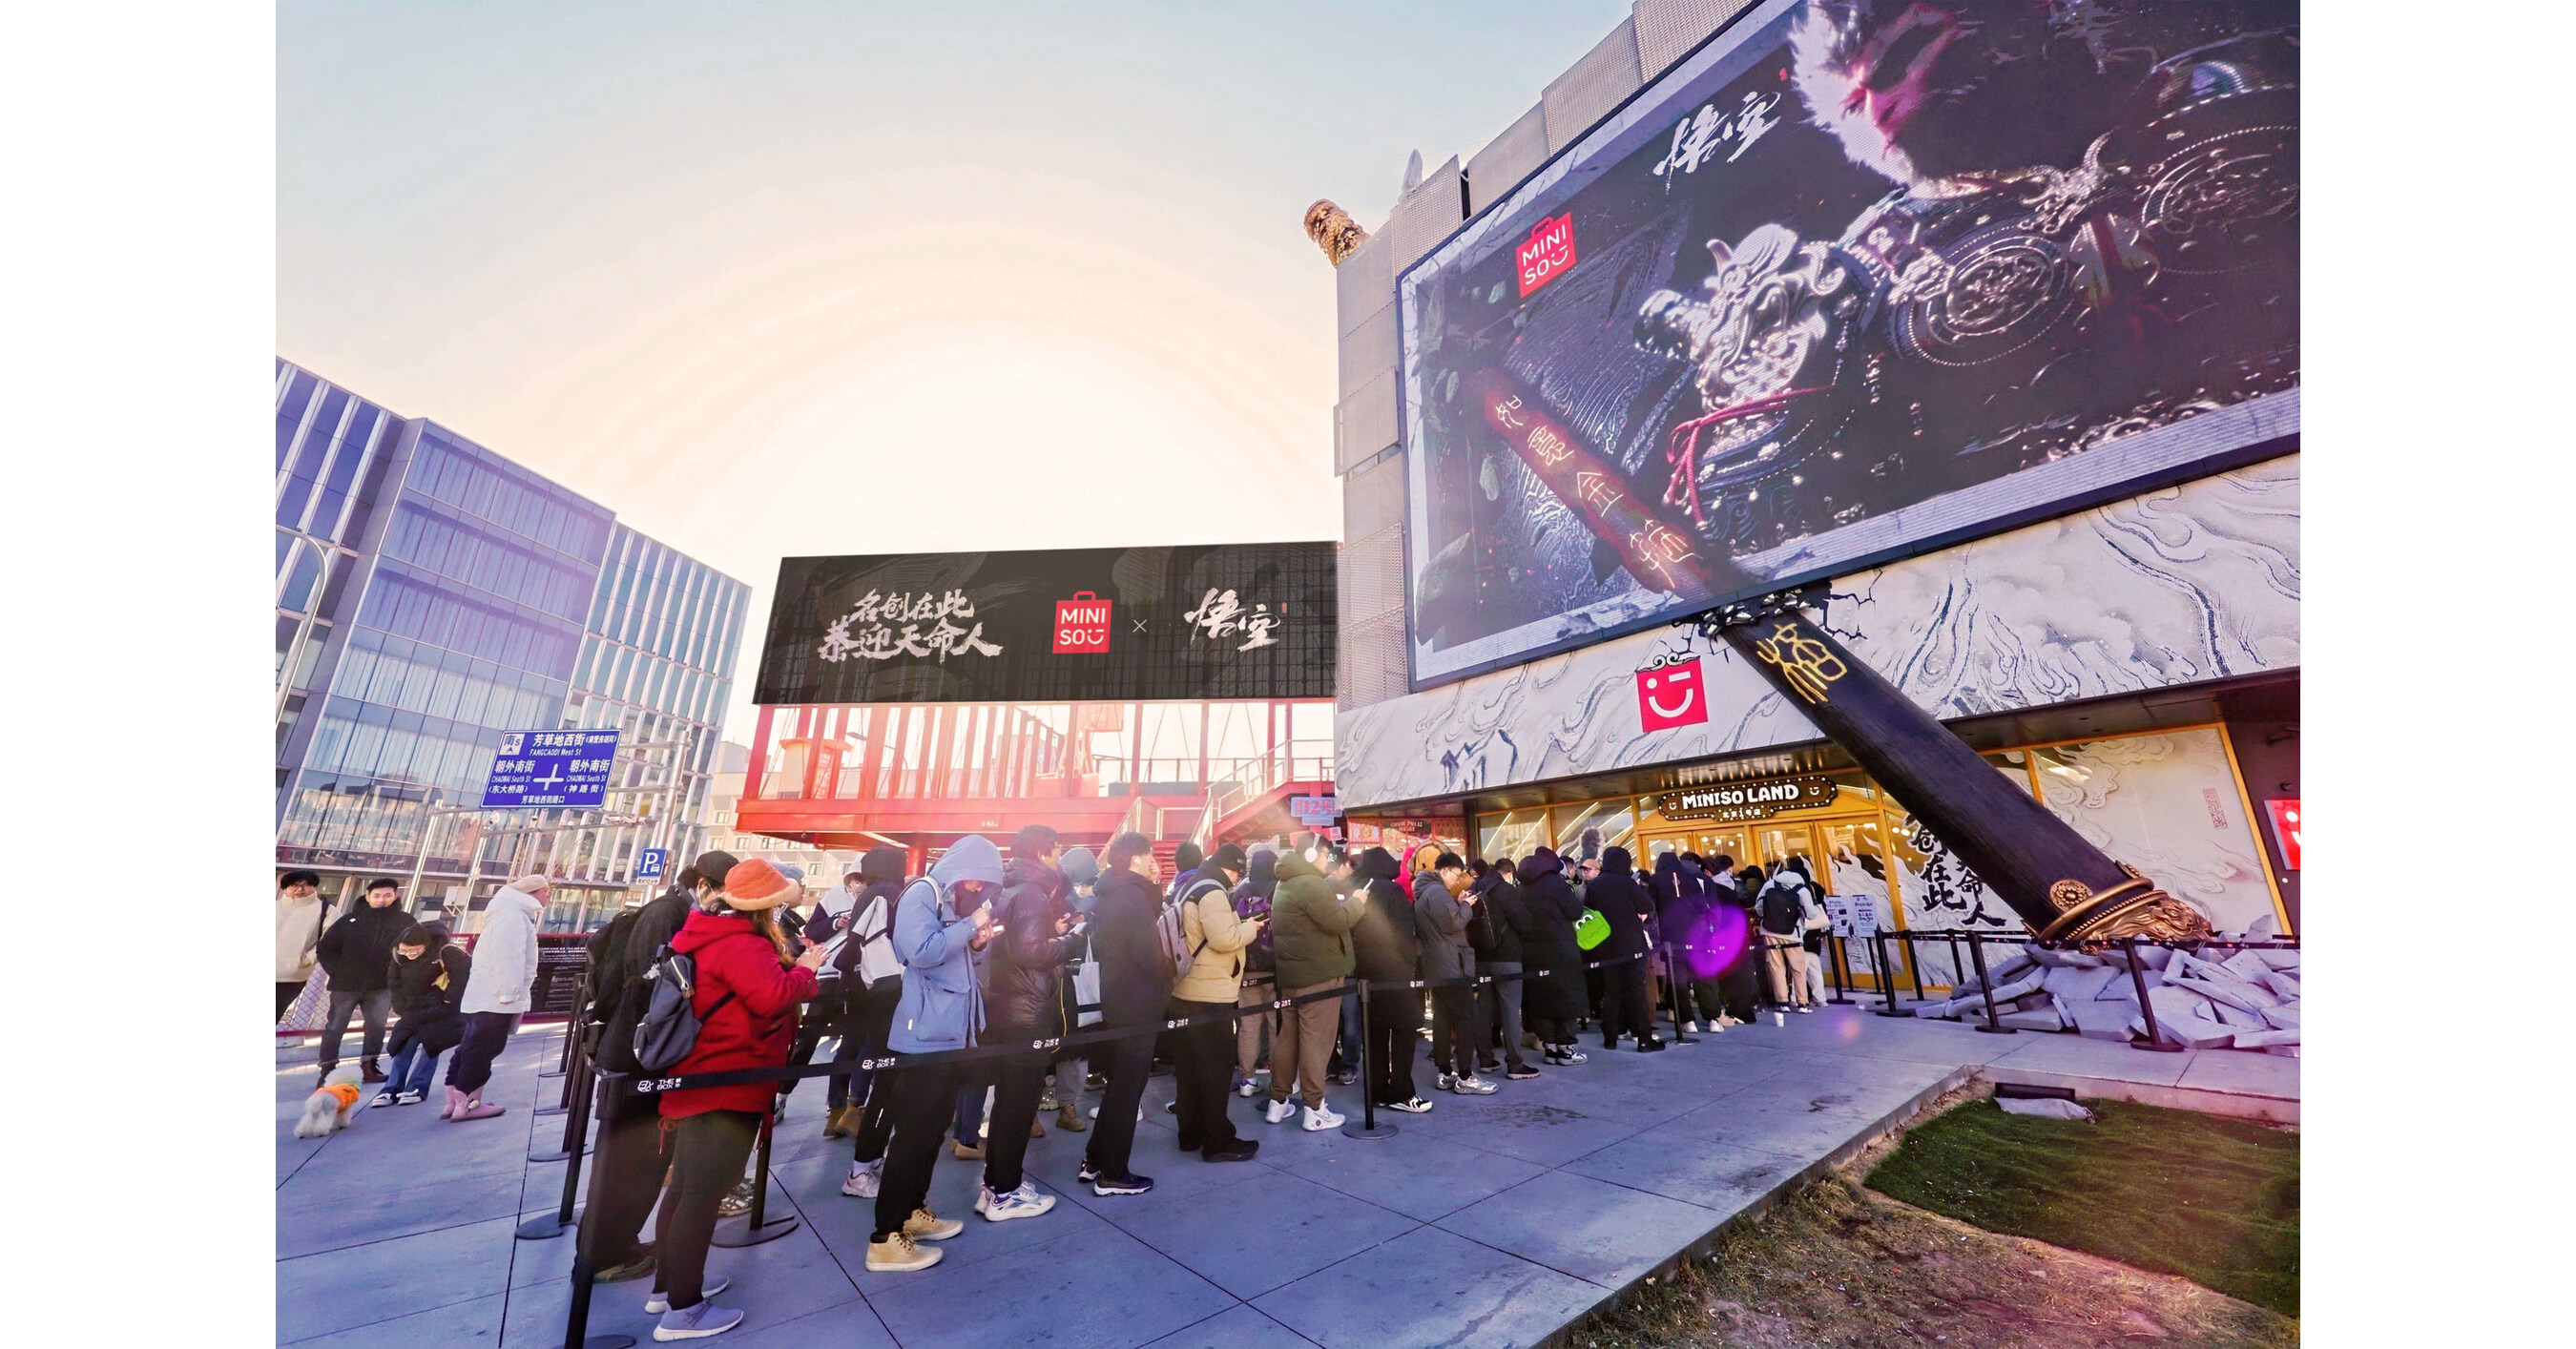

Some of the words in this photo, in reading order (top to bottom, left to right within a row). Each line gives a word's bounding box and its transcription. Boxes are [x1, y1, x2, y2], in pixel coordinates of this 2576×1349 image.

[1522, 225, 1568, 268] MINI
[848, 588, 974, 623] 名创在此
[1060, 607, 1107, 625] MINI
[818, 615, 1005, 665] 恭迎天命人
[504, 735, 515, 747] 南
[532, 733, 586, 747] 芳草地西街
[529, 748, 560, 757] FANGCAODI
[561, 748, 574, 757] West
[574, 748, 582, 757] St
[494, 759, 536, 774] 朝外南街
[569, 758, 611, 773] 朝外南街
[526, 775, 531, 783] St
[600, 774, 607, 782] St
[1682, 790, 1744, 811] MINISO
[1747, 783, 1799, 803] LAND
[640, 852, 659, 874] P
